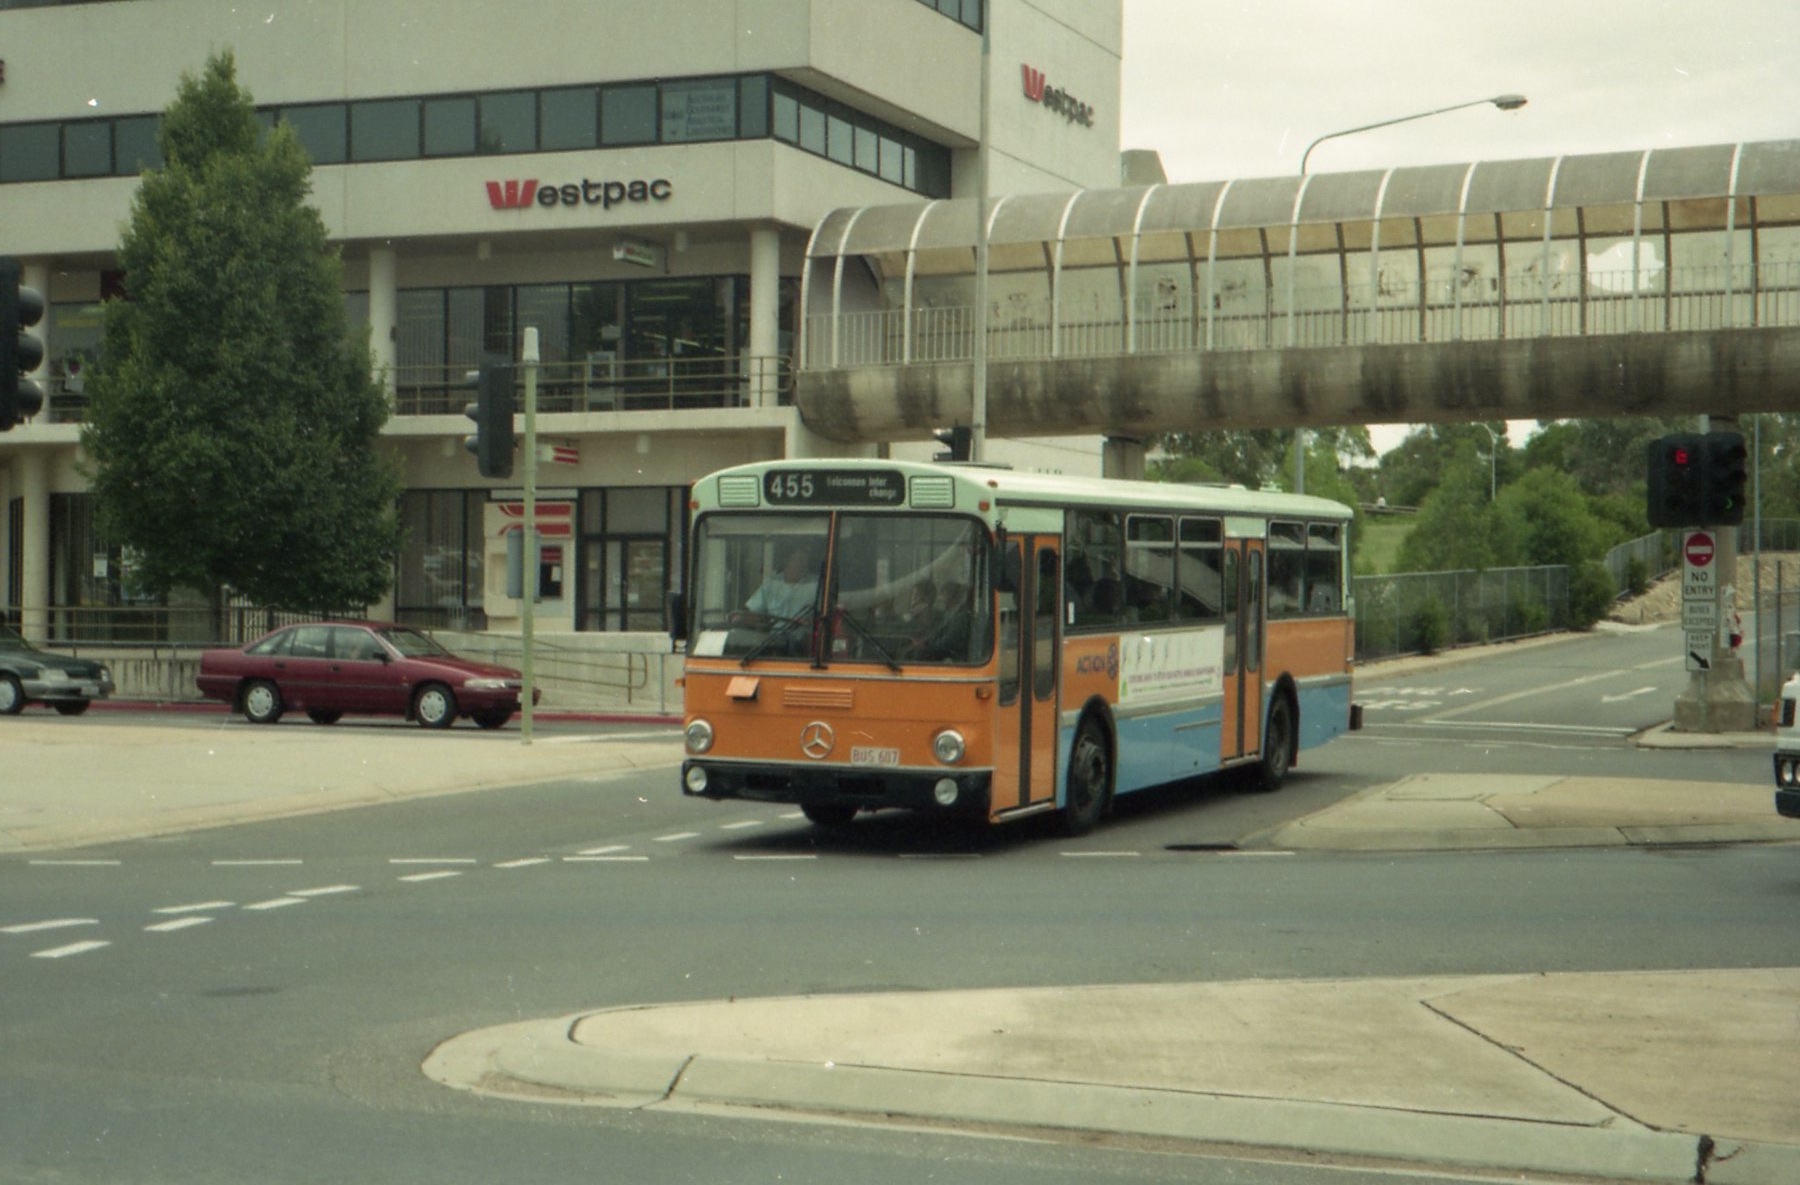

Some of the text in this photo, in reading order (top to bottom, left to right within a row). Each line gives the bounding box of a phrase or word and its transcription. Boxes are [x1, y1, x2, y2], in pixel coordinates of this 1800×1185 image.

[1020, 63, 1094, 128] Westpac
[485, 178, 672, 210] Westpac
[770, 474, 814, 498] 455
[1691, 571, 1708, 582] NO
[1685, 585, 1713, 595] ENTRY
[852, 749, 897, 763] BUS 607
